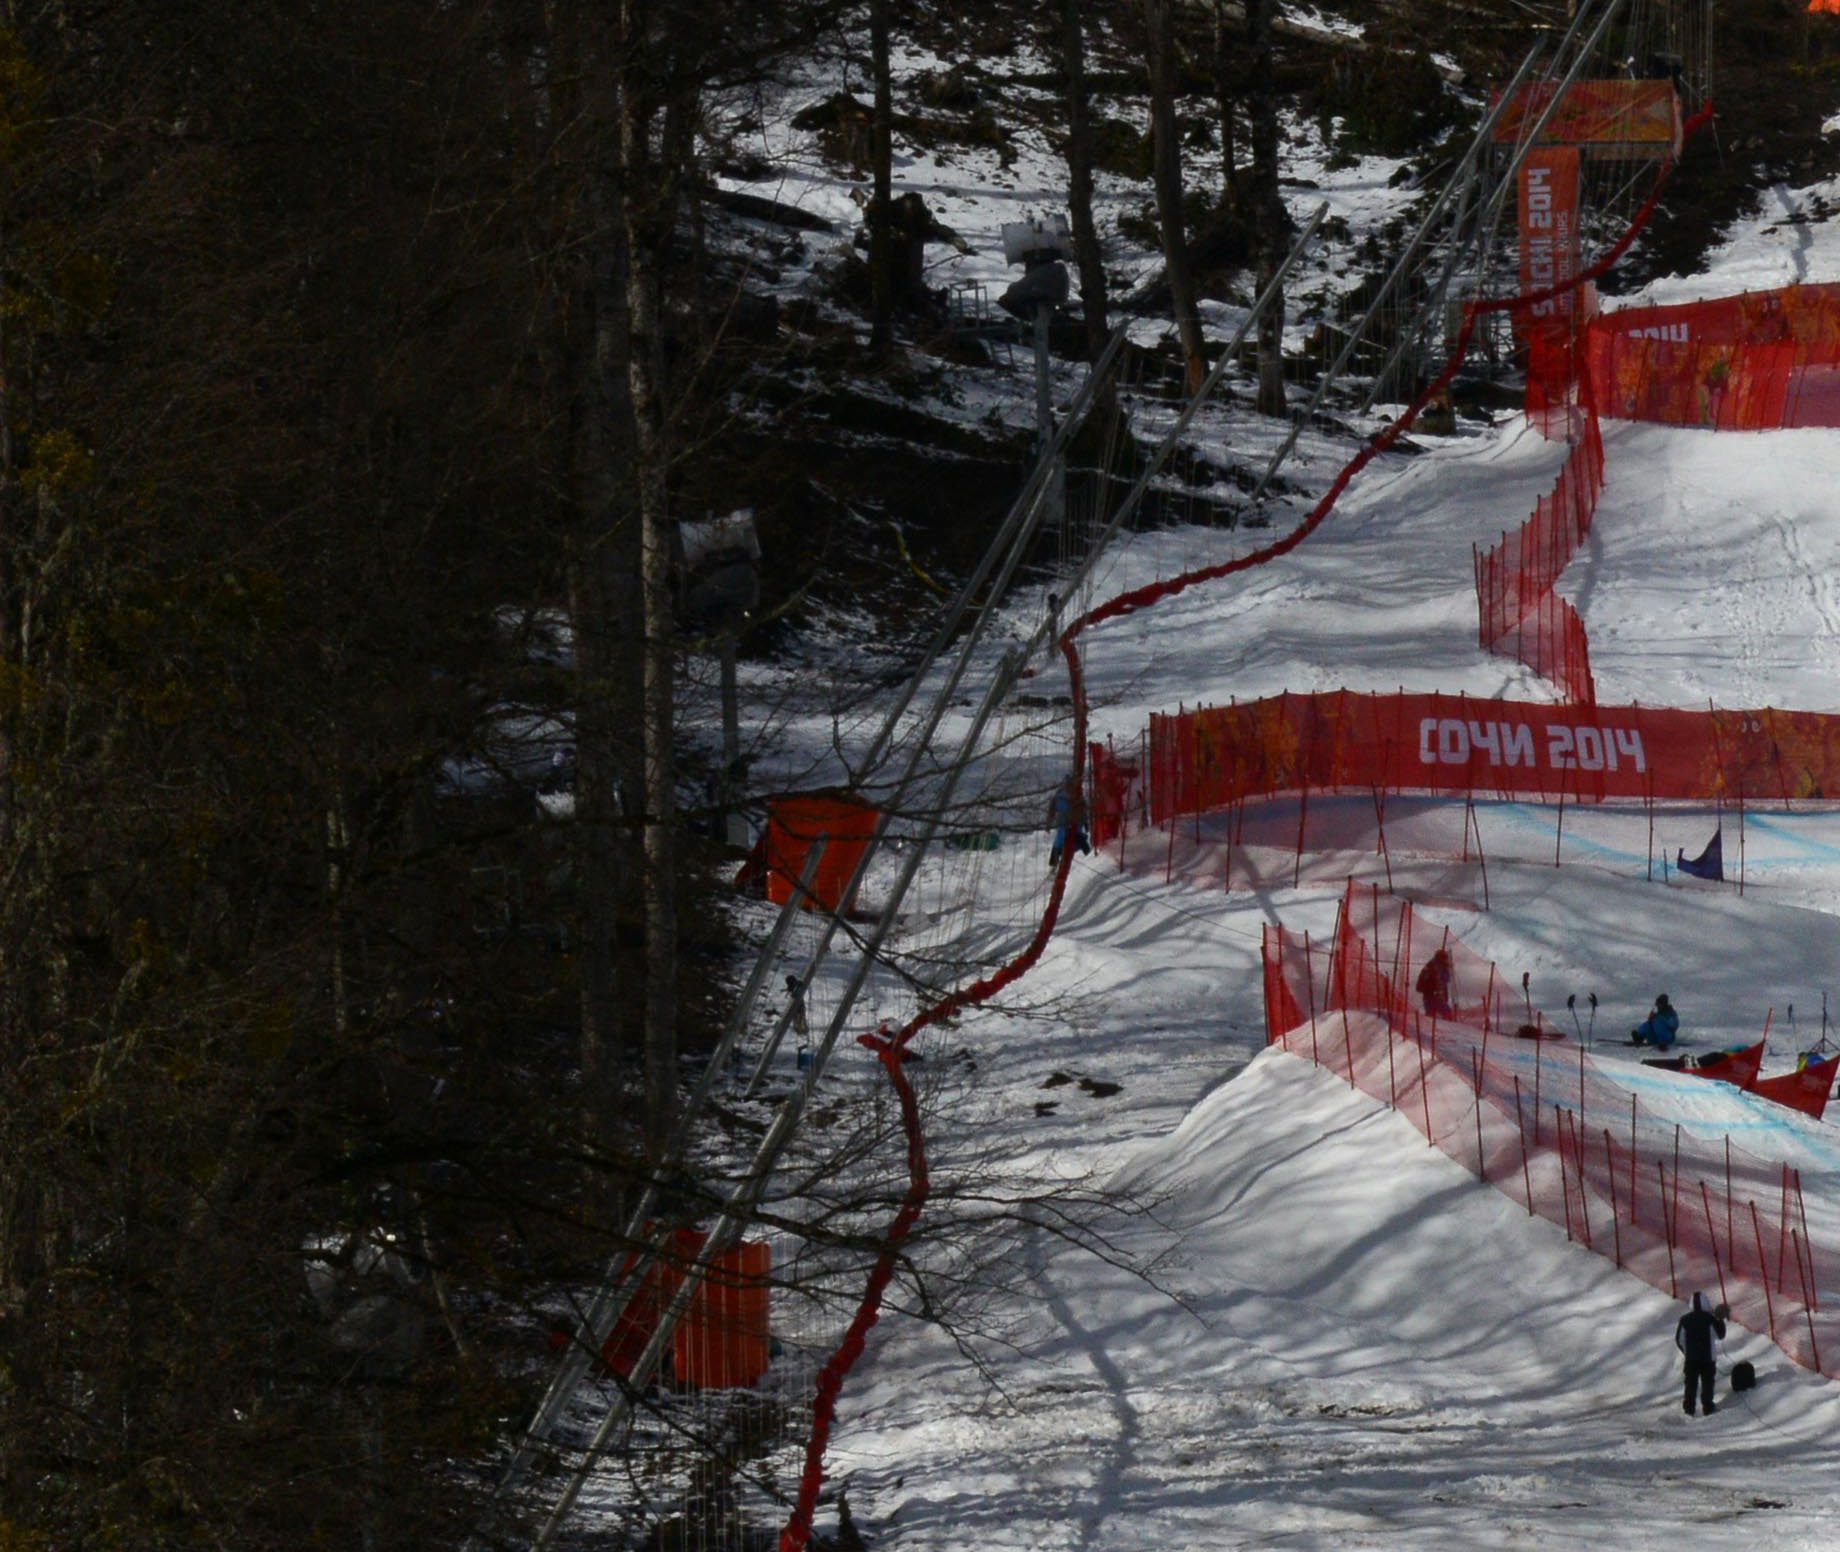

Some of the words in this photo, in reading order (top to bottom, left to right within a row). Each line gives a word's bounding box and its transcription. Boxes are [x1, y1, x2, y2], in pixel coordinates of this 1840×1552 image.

[1528, 168, 1553, 228] 2014
[1419, 718, 1536, 767] СОЧИ
[1546, 724, 1646, 773] 2014
